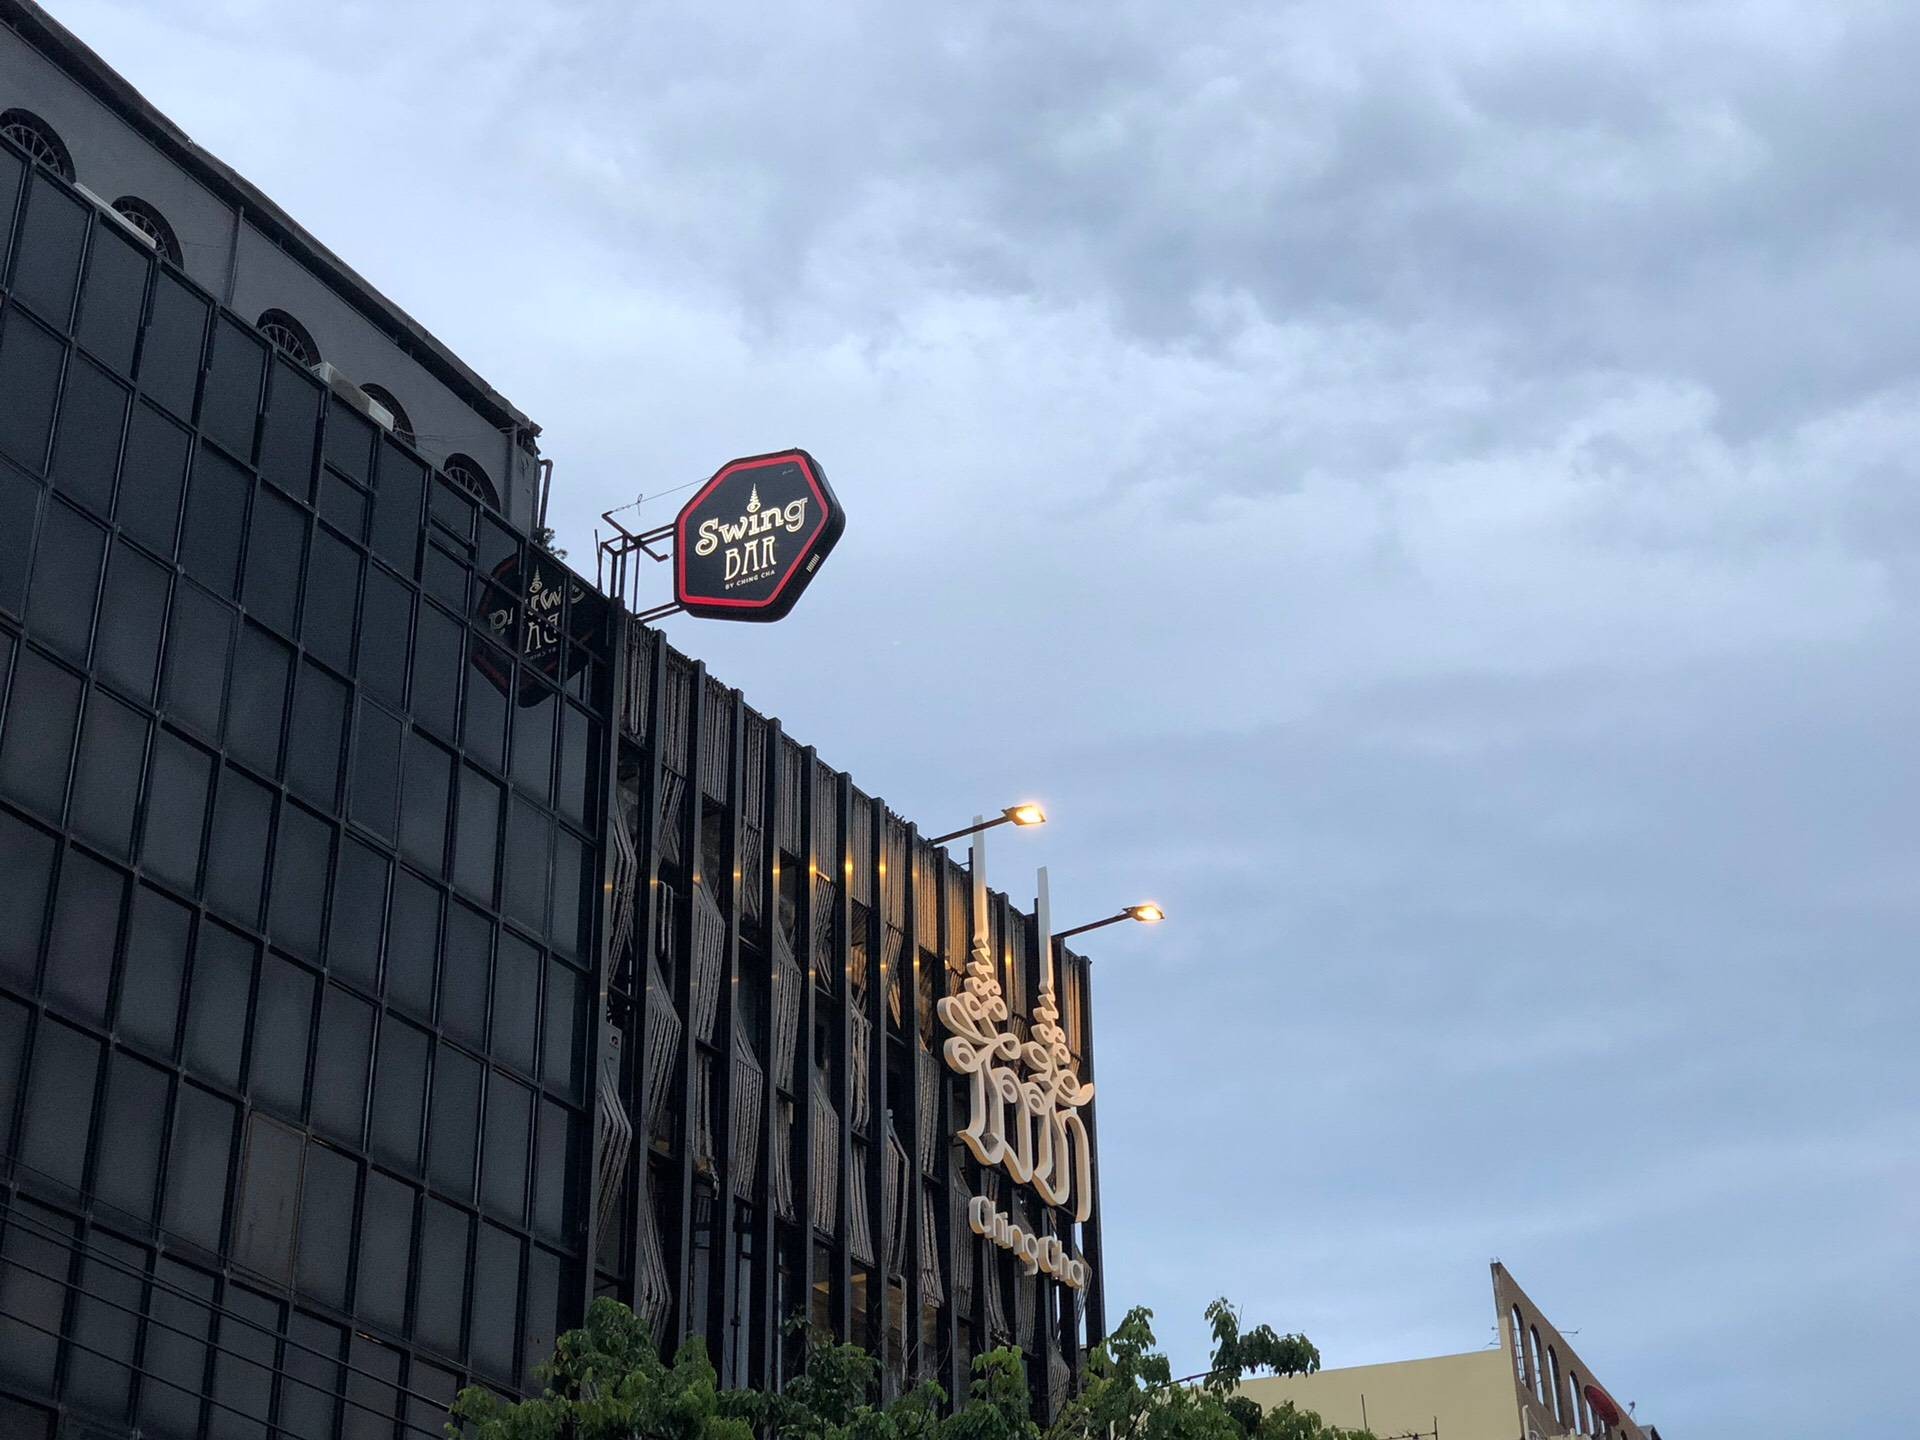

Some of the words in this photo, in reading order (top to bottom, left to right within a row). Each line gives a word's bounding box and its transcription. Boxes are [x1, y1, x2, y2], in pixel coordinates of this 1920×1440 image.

[695, 484, 808, 557] Swing
[724, 535, 777, 581] BAR
[736, 574, 759, 586] CHING
[760, 569, 776, 579] CHA
